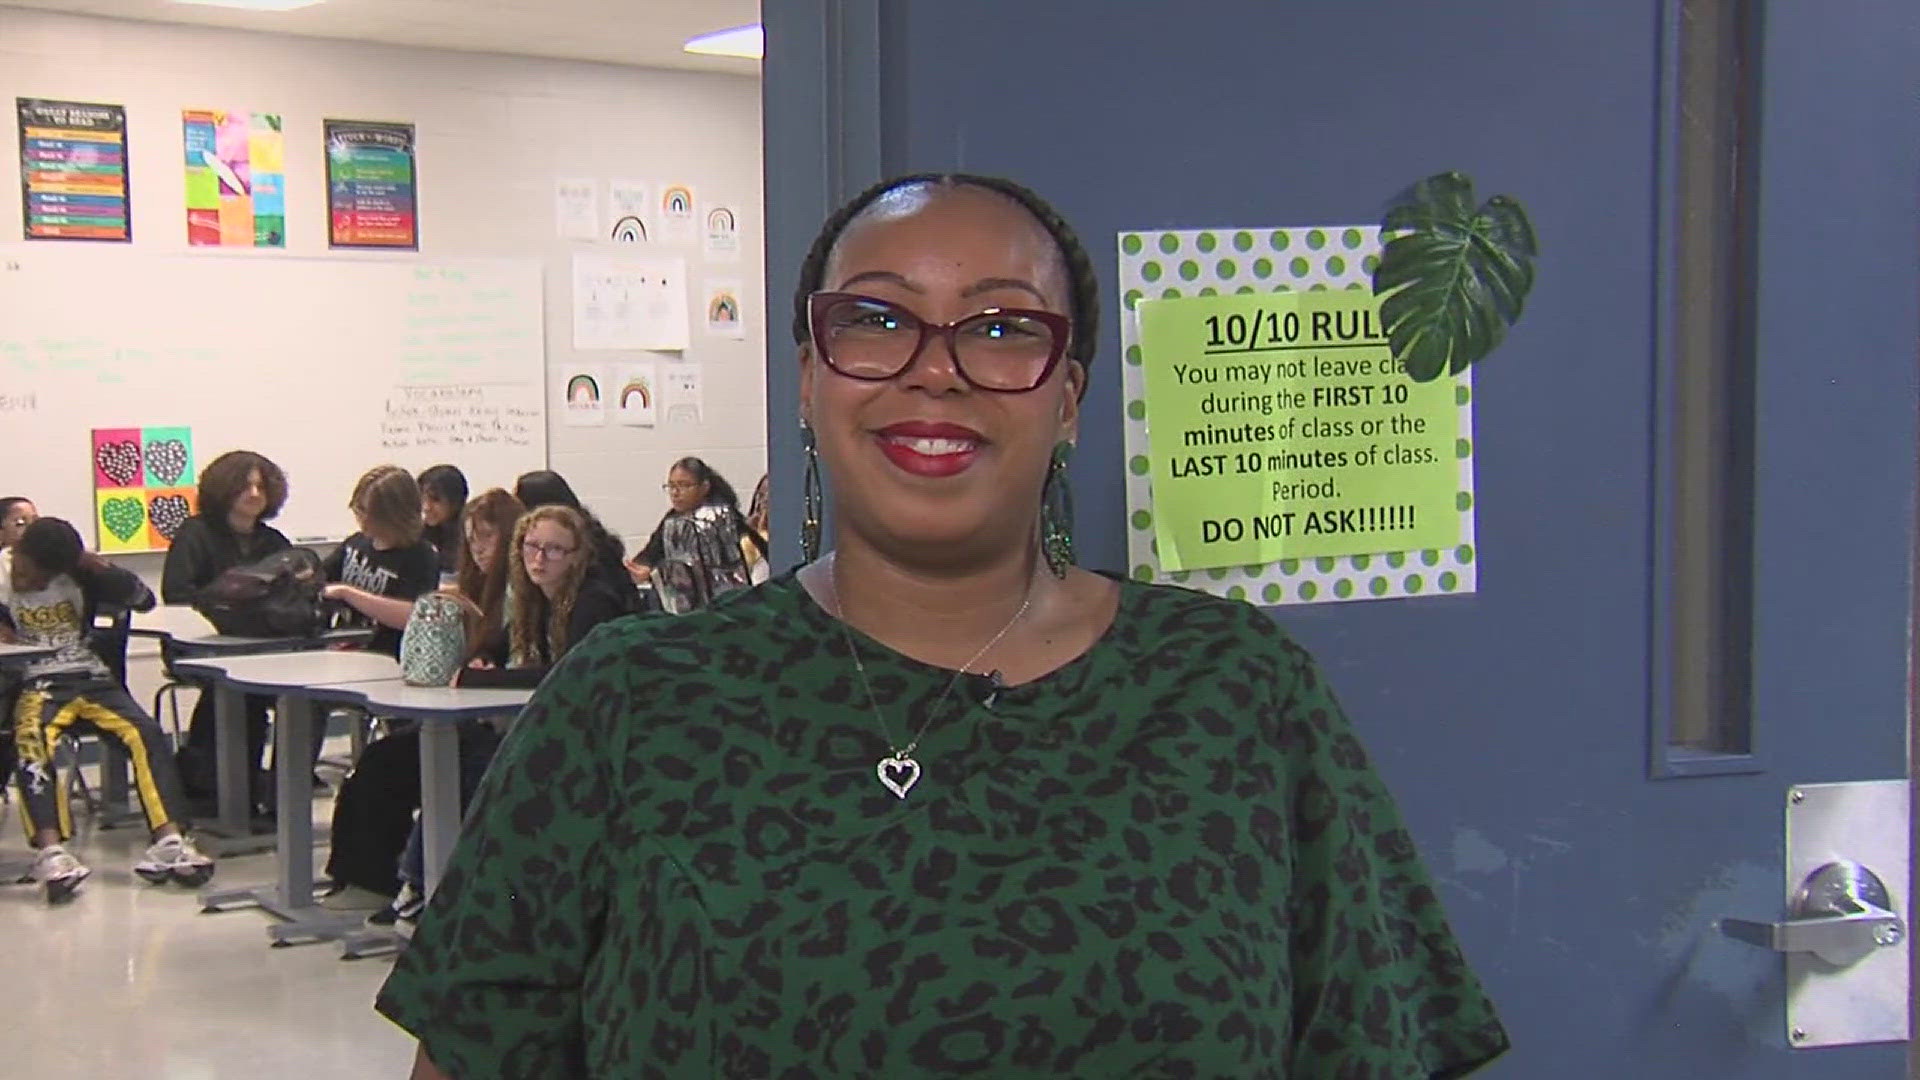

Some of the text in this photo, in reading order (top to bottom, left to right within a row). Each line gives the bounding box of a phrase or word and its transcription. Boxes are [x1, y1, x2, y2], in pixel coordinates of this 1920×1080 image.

[1205, 309, 1391, 350] 10/10 RUL
[1174, 354, 1408, 385] You may not leave cla
[1201, 384, 1409, 415] during the FIRST 10
[1184, 413, 1426, 446] minutes of class or the
[1171, 444, 1439, 478] LAST 10 minutes of class.
[1273, 476, 1341, 501] Period.
[1202, 505, 1415, 544] DO NOT ASK!!!!!!
